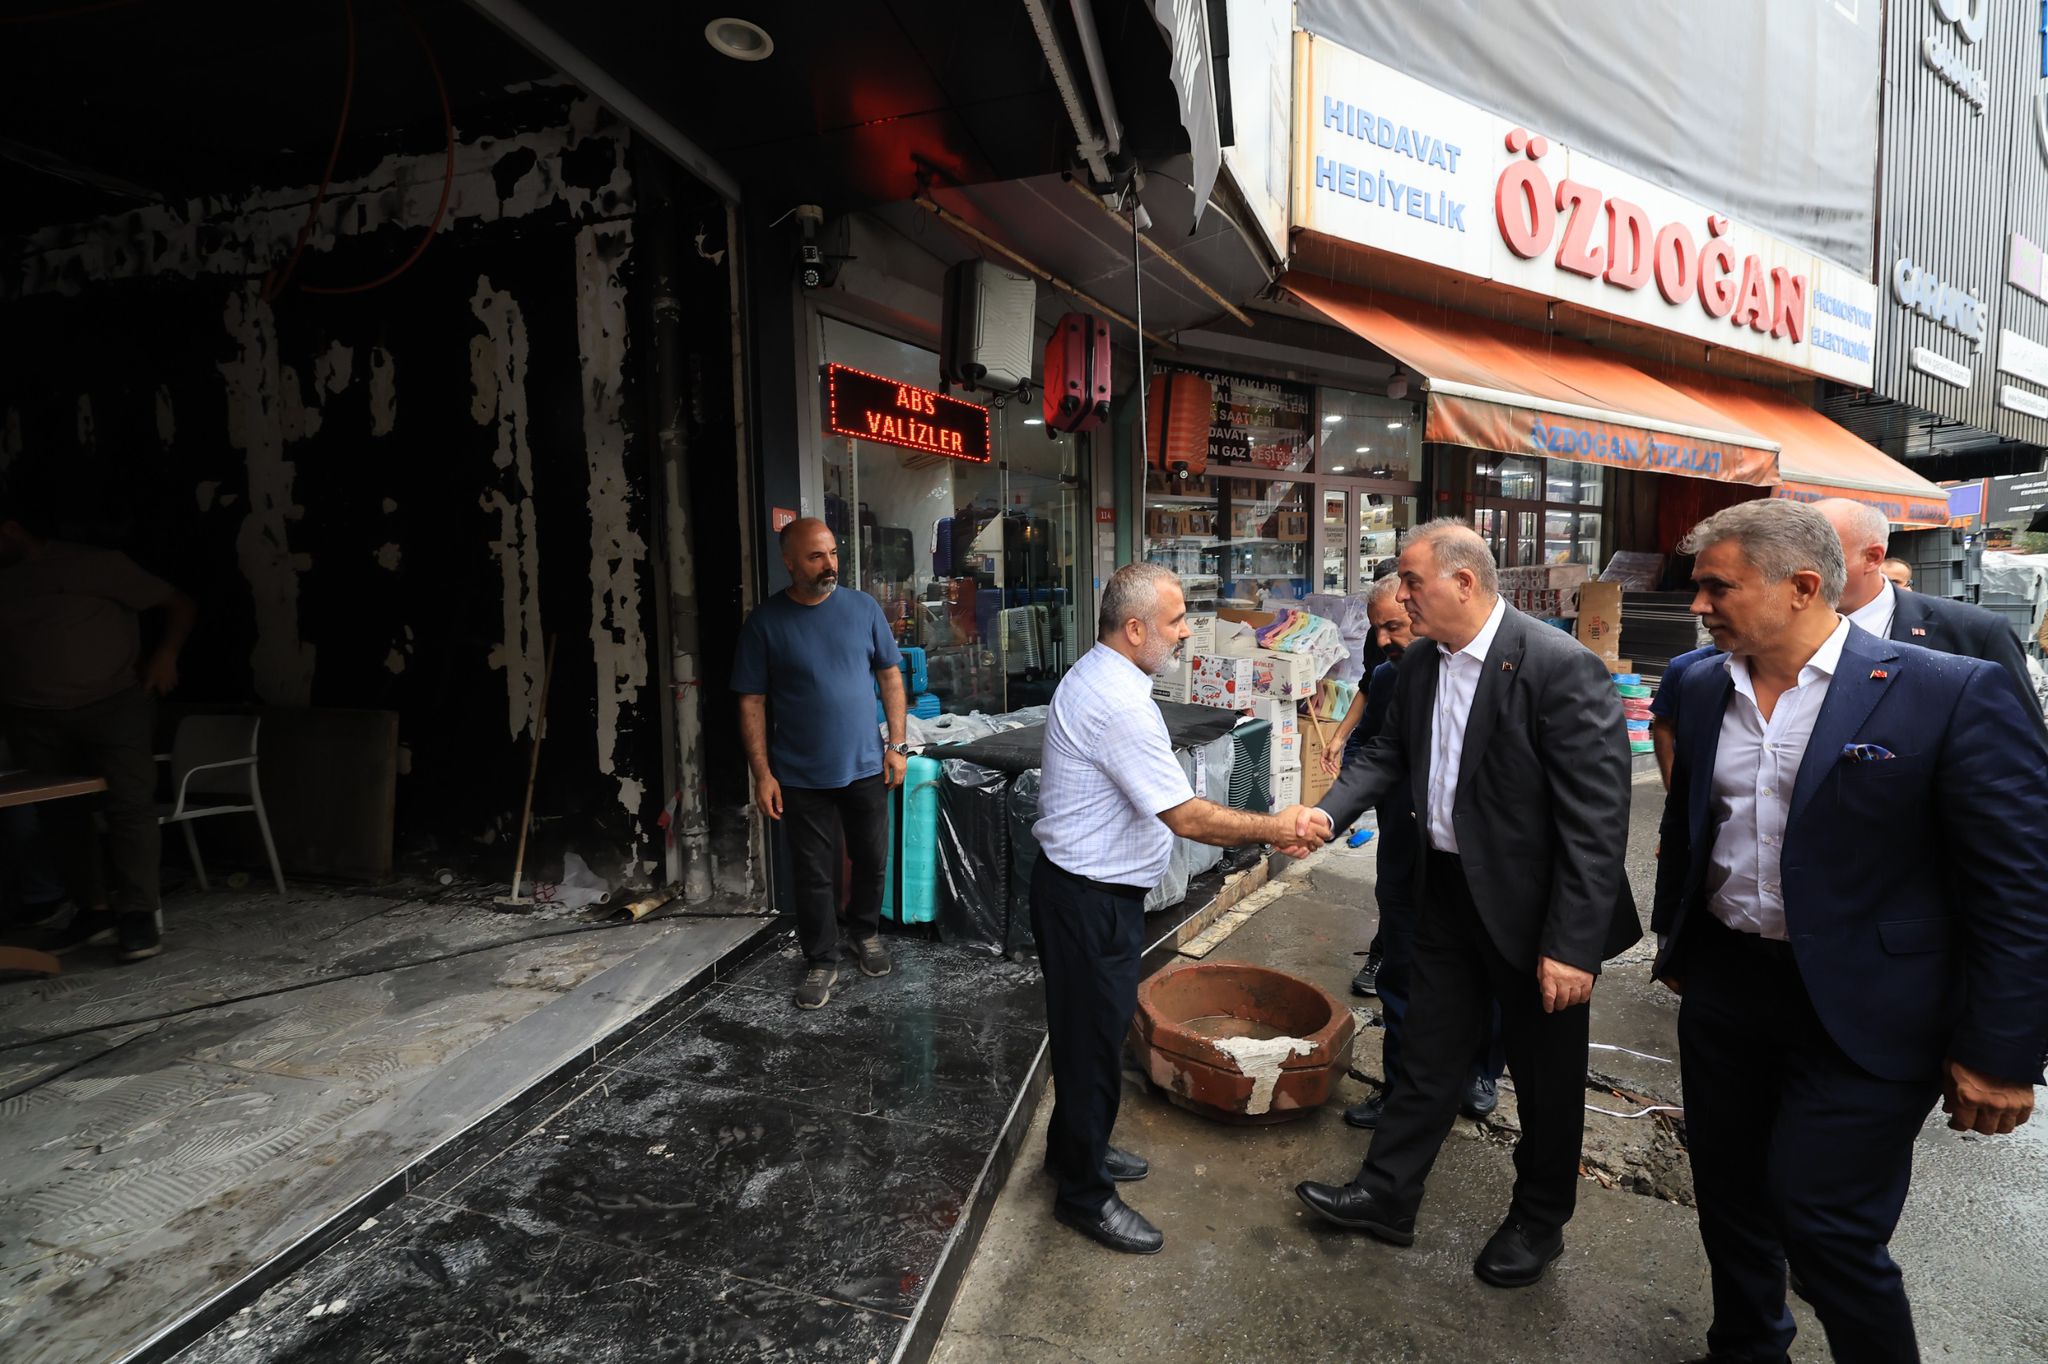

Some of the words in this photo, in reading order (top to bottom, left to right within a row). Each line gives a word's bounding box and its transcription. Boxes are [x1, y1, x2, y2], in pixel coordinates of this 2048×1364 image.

[1323, 95, 1462, 174] HIRDAVAT
[1315, 155, 1466, 232] HEDİYELİK
[1495, 127, 1808, 344] ÖZDOĞAN
[1813, 289, 1872, 331] PROMOSYON
[1811, 326, 1871, 364] ELEKTRONİK
[896, 386, 936, 415] ABS
[1219, 409, 1275, 427] SAATLERİ
[866, 410, 963, 453] VALİZLER
[1221, 445, 1247, 458] GAZ
